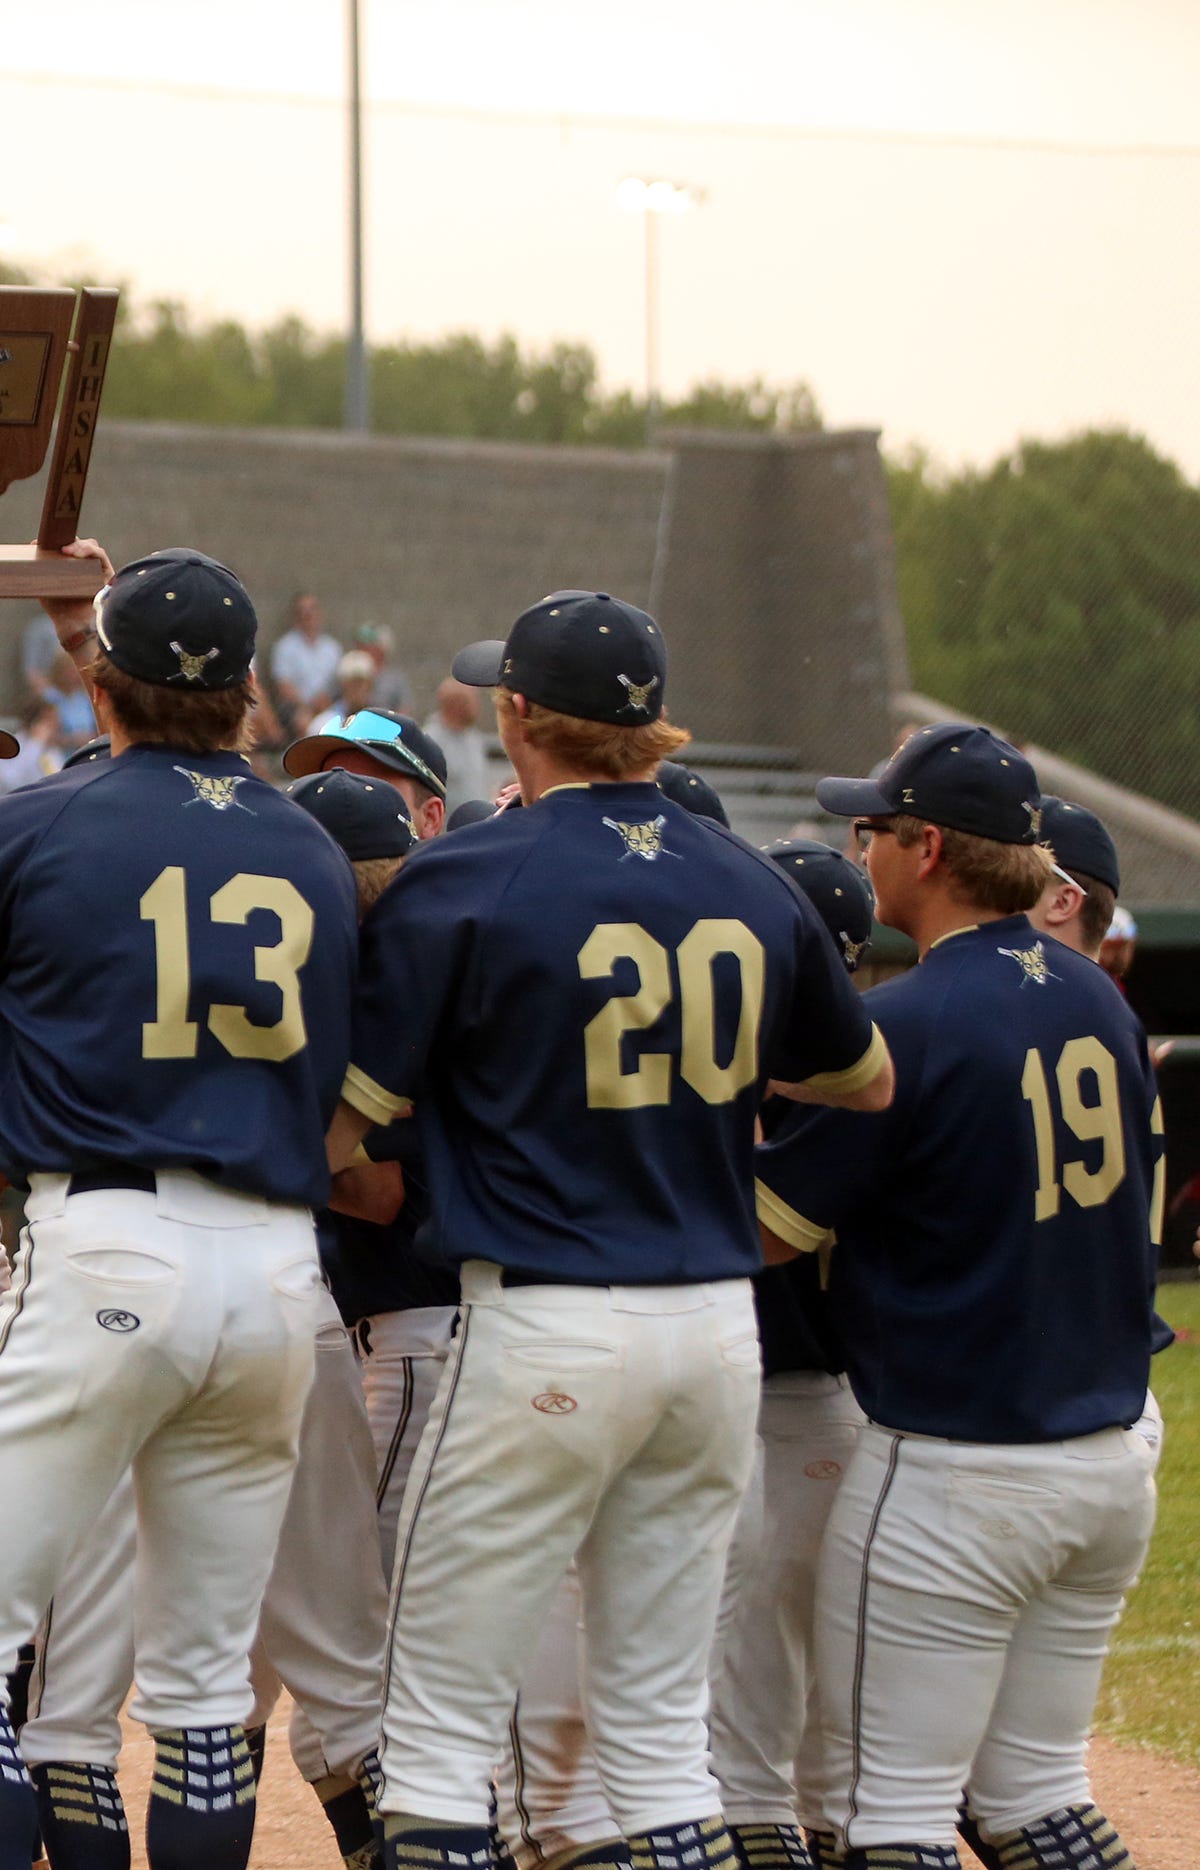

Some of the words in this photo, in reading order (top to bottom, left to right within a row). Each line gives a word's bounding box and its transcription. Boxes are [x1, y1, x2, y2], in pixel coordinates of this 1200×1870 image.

[57, 341, 102, 514] IHSAA
[902, 788, 915, 803] Z
[139, 865, 315, 1062] 13
[576, 918, 765, 1109] 20
[1020, 1035, 1126, 1223] 19
